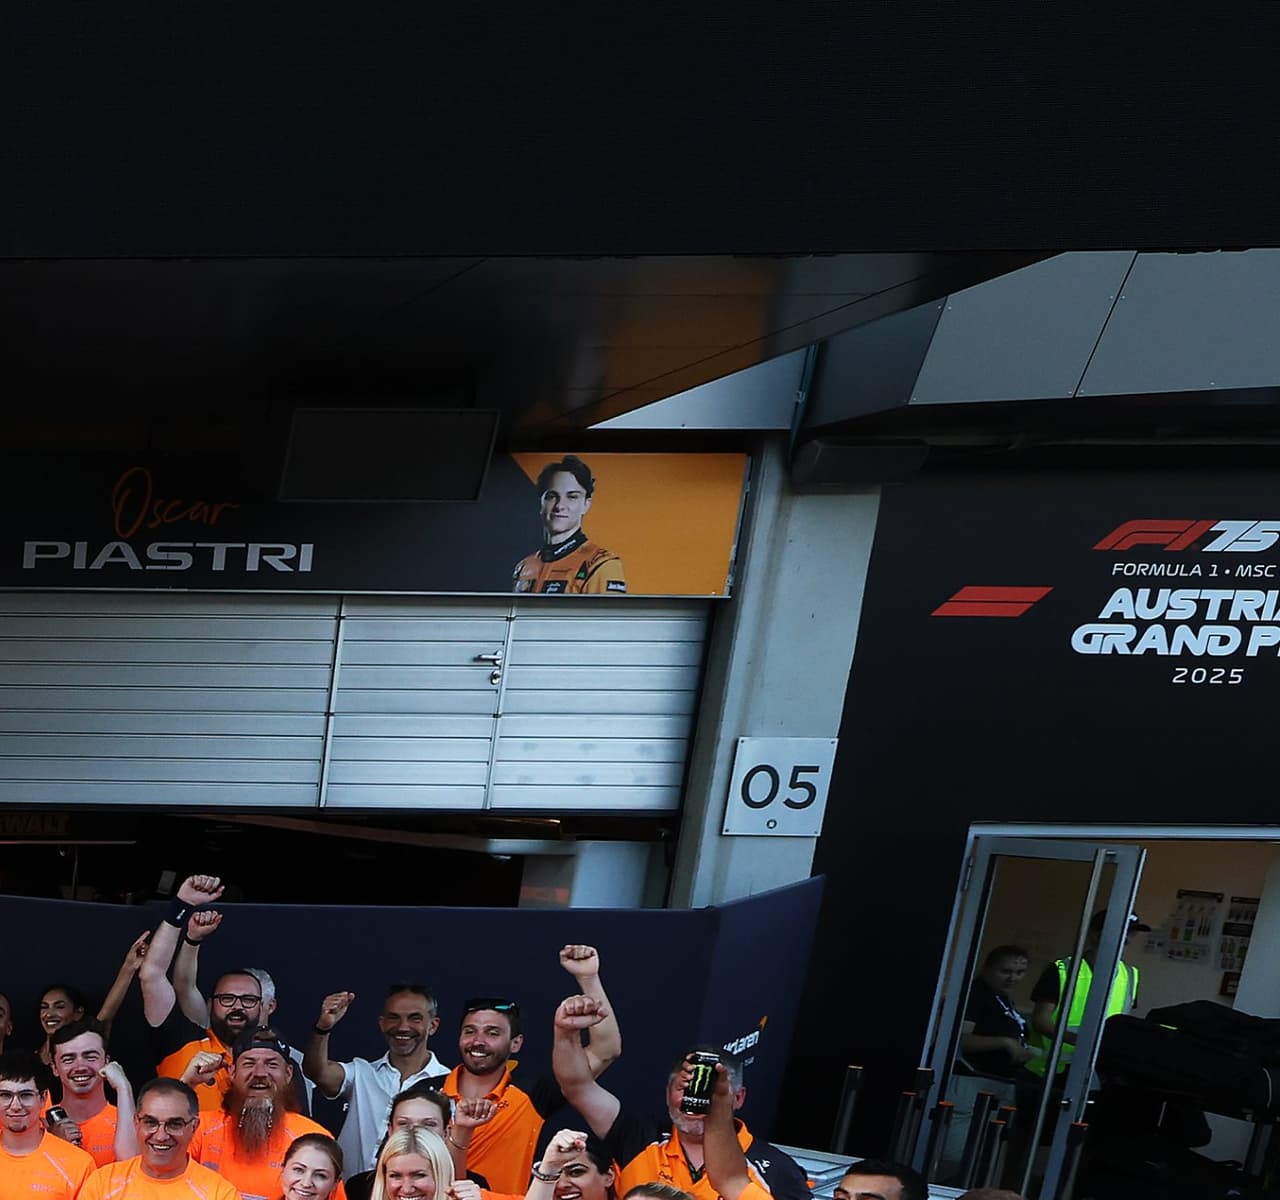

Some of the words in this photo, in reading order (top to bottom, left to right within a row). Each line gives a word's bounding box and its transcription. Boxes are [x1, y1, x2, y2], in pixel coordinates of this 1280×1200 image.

[110, 467, 240, 539] Oscar
[23, 541, 314, 573] PIASTRI
[1112, 563, 1202, 576] FORMULA
[1209, 565, 1218, 576] 1
[1235, 565, 1277, 577] MSC
[1071, 624, 1242, 656] GRAND
[1172, 668, 1244, 684] 2025
[741, 764, 820, 811] 05
